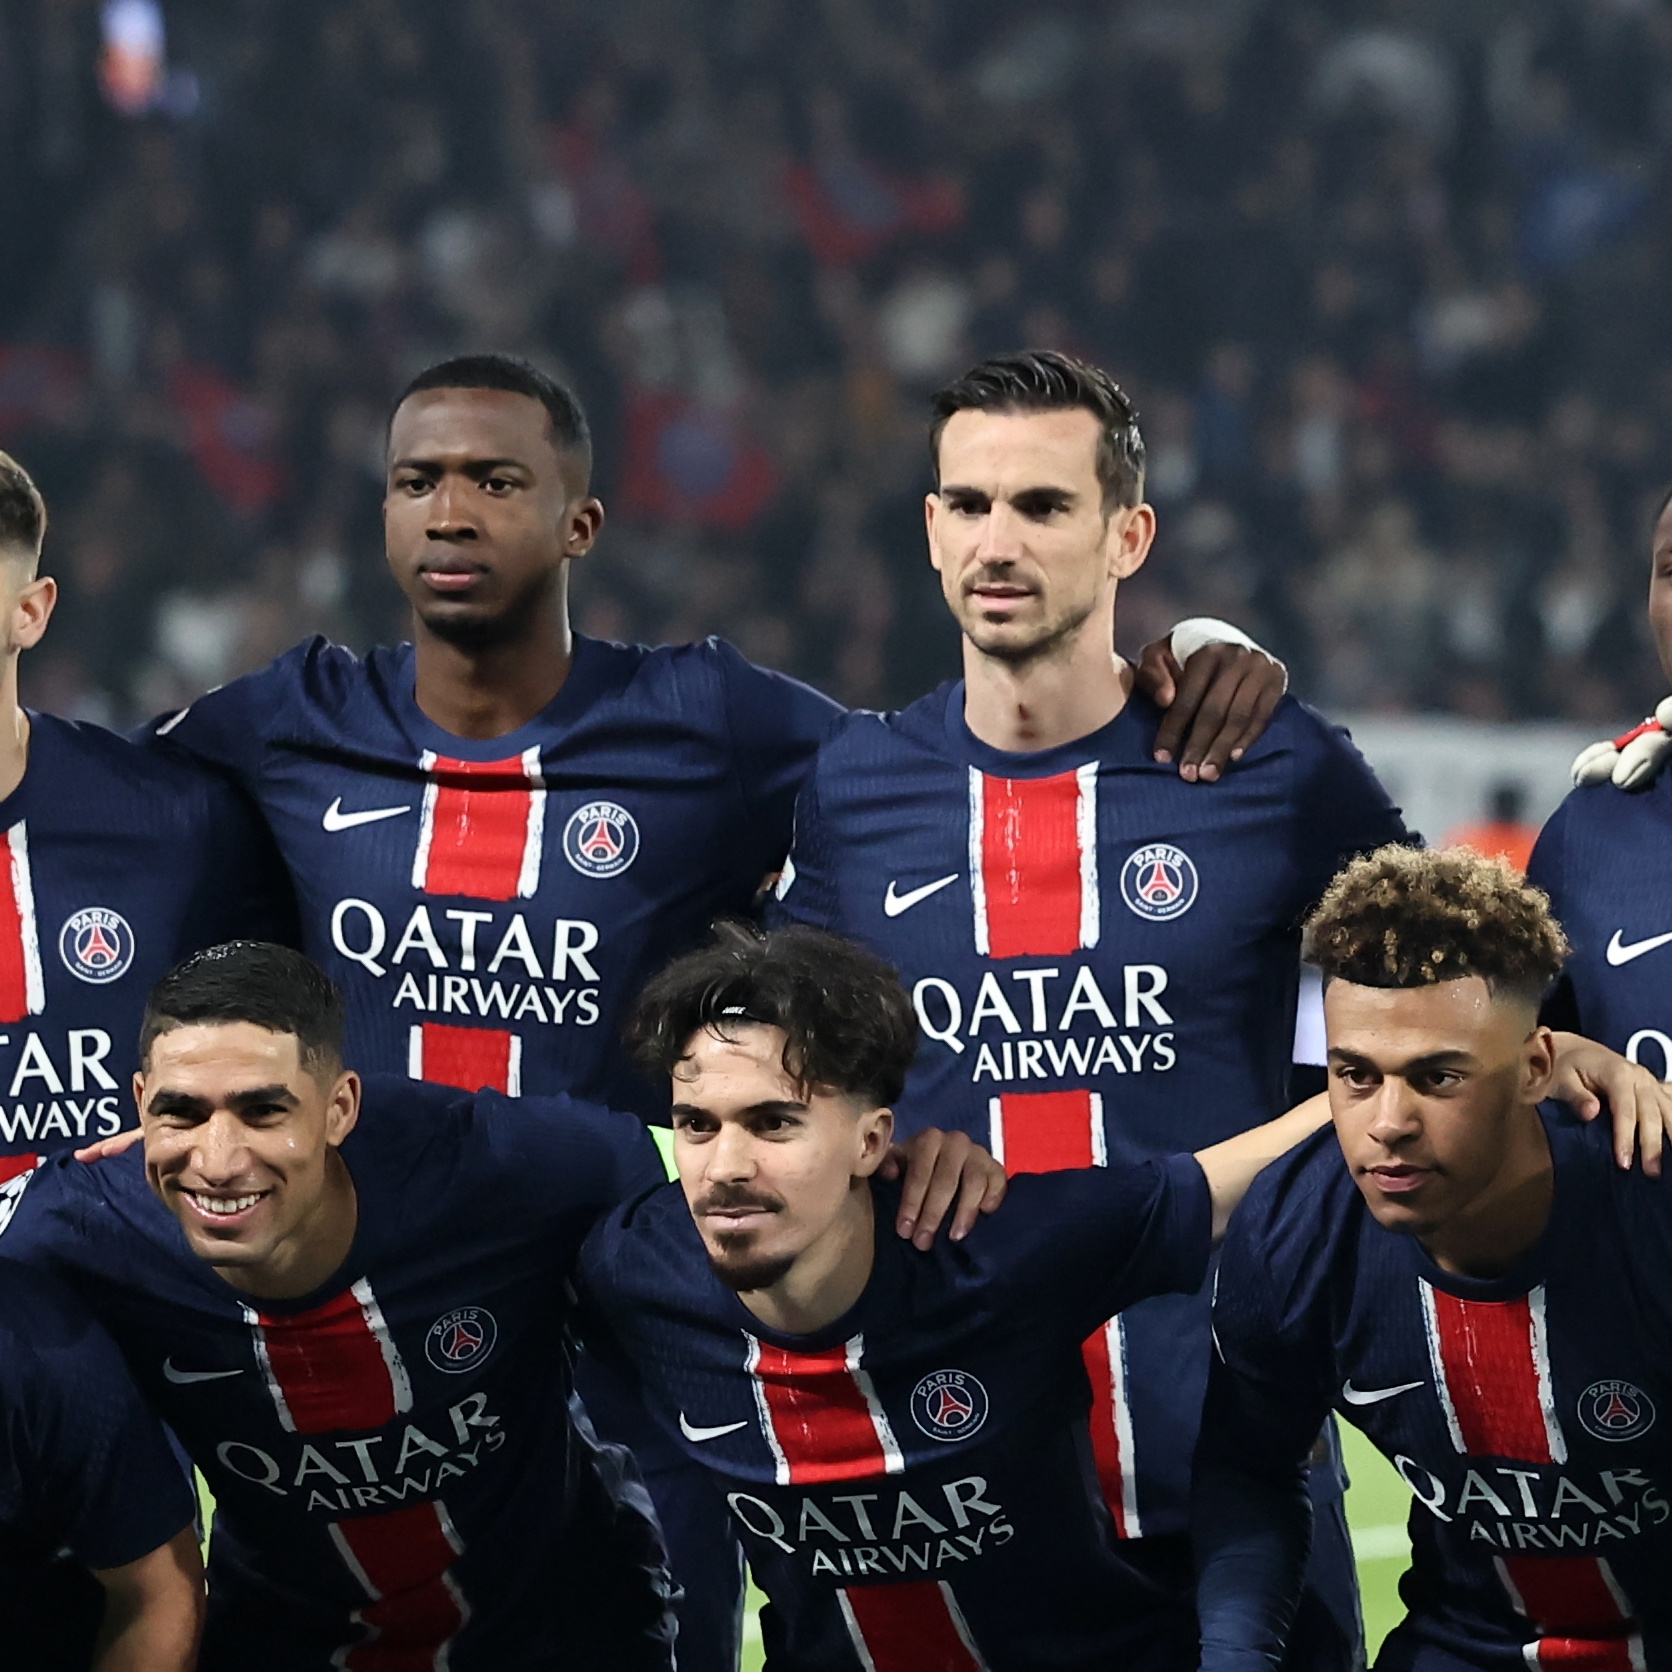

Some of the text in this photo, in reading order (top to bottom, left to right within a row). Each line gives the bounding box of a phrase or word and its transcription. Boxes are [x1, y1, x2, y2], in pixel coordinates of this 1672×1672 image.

[578, 806, 628, 827] PARIS
[1133, 848, 1184, 868] PARIS
[71, 911, 120, 932] PARIS
[331, 898, 601, 983] QATAR
[392, 972, 600, 1025] AIRWAYS
[913, 964, 1174, 1054] QATAR
[972, 1032, 1177, 1083] AIRWAYS
[433, 1310, 479, 1336] PARIS
[917, 1373, 965, 1397] PARIS
[217, 1391, 501, 1496] QATAR
[307, 1430, 506, 1512] AIRWAYS
[727, 1475, 1002, 1554] QATAR
[1395, 1453, 1650, 1523] QATAR
[1470, 1487, 1670, 1549] AIRWAYS
[812, 1514, 1014, 1576] AIRWAYS
